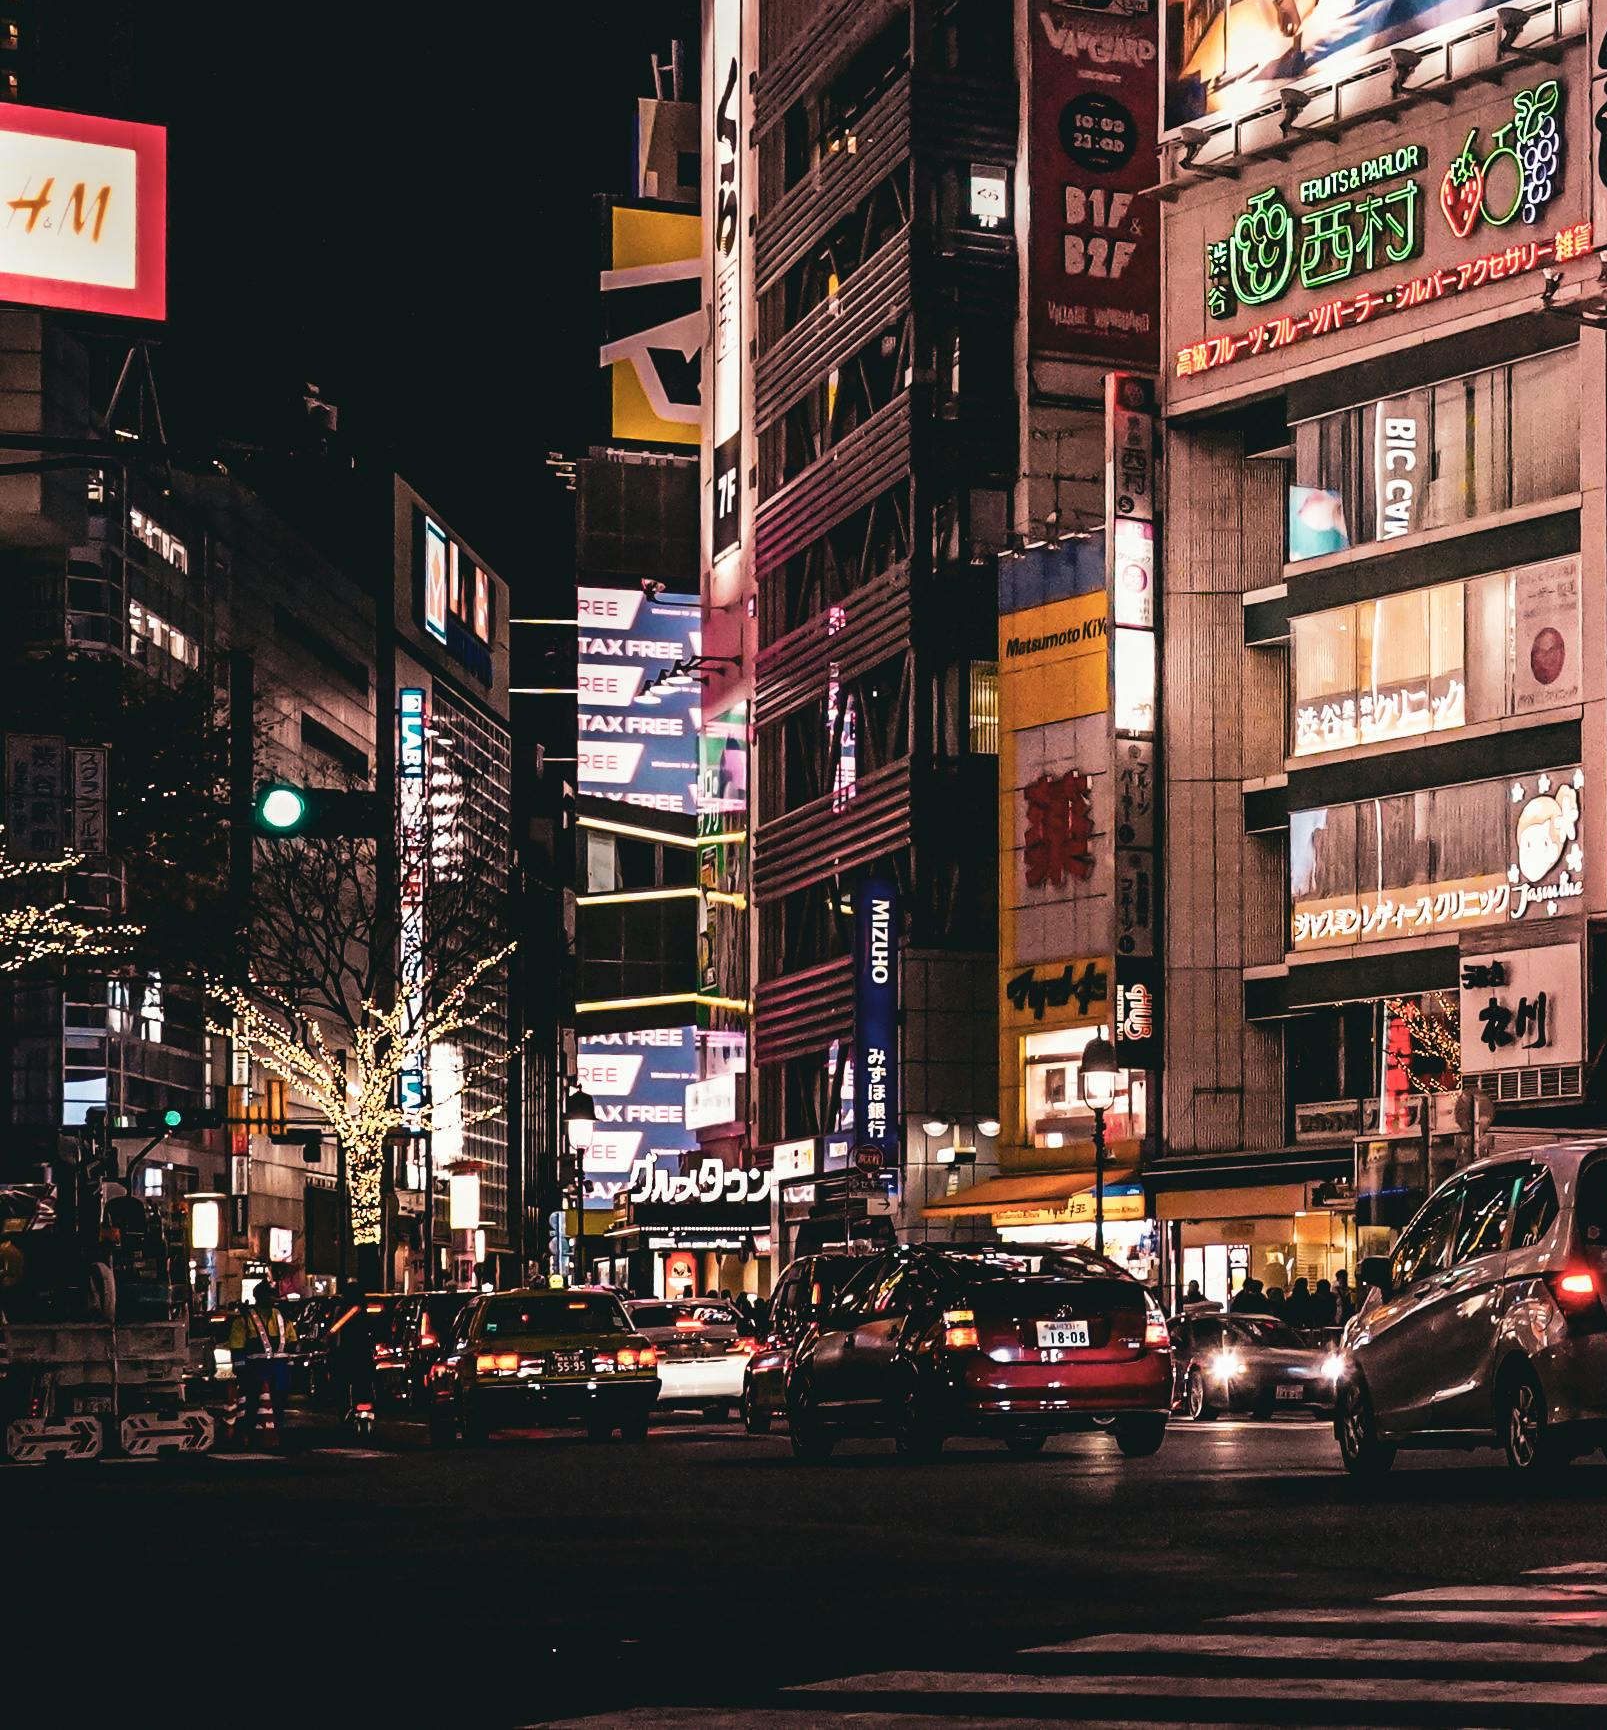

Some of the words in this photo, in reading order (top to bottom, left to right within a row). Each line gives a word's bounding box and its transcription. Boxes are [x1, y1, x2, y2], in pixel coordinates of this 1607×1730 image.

[1065, 185, 1134, 230] B1F
[1064, 233, 1137, 279] B2F
[1301, 180, 1419, 289] 西村
[1207, 242, 1229, 318] 渋谷
[1385, 418, 1417, 472] BIC
[717, 468, 737, 520] 7F
[578, 636, 623, 658] TAX
[626, 639, 684, 660] FREE
[1006, 627, 1080, 659] Matsumoto
[578, 714, 623, 734] TAX
[626, 716, 684, 737] FREE
[1511, 878, 1584, 920] Jasmine
[871, 899, 889, 984] MIZUHO
[1123, 982, 1153, 1040] HUB
[626, 1029, 684, 1047] FREE
[594, 1105, 623, 1123] AX
[626, 1105, 684, 1123] FREE
[867, 1047, 888, 1139] みずほ銀行
[630, 1152, 772, 1203] グルメタウン
[1050, 1331, 1087, 1344] 18-08
